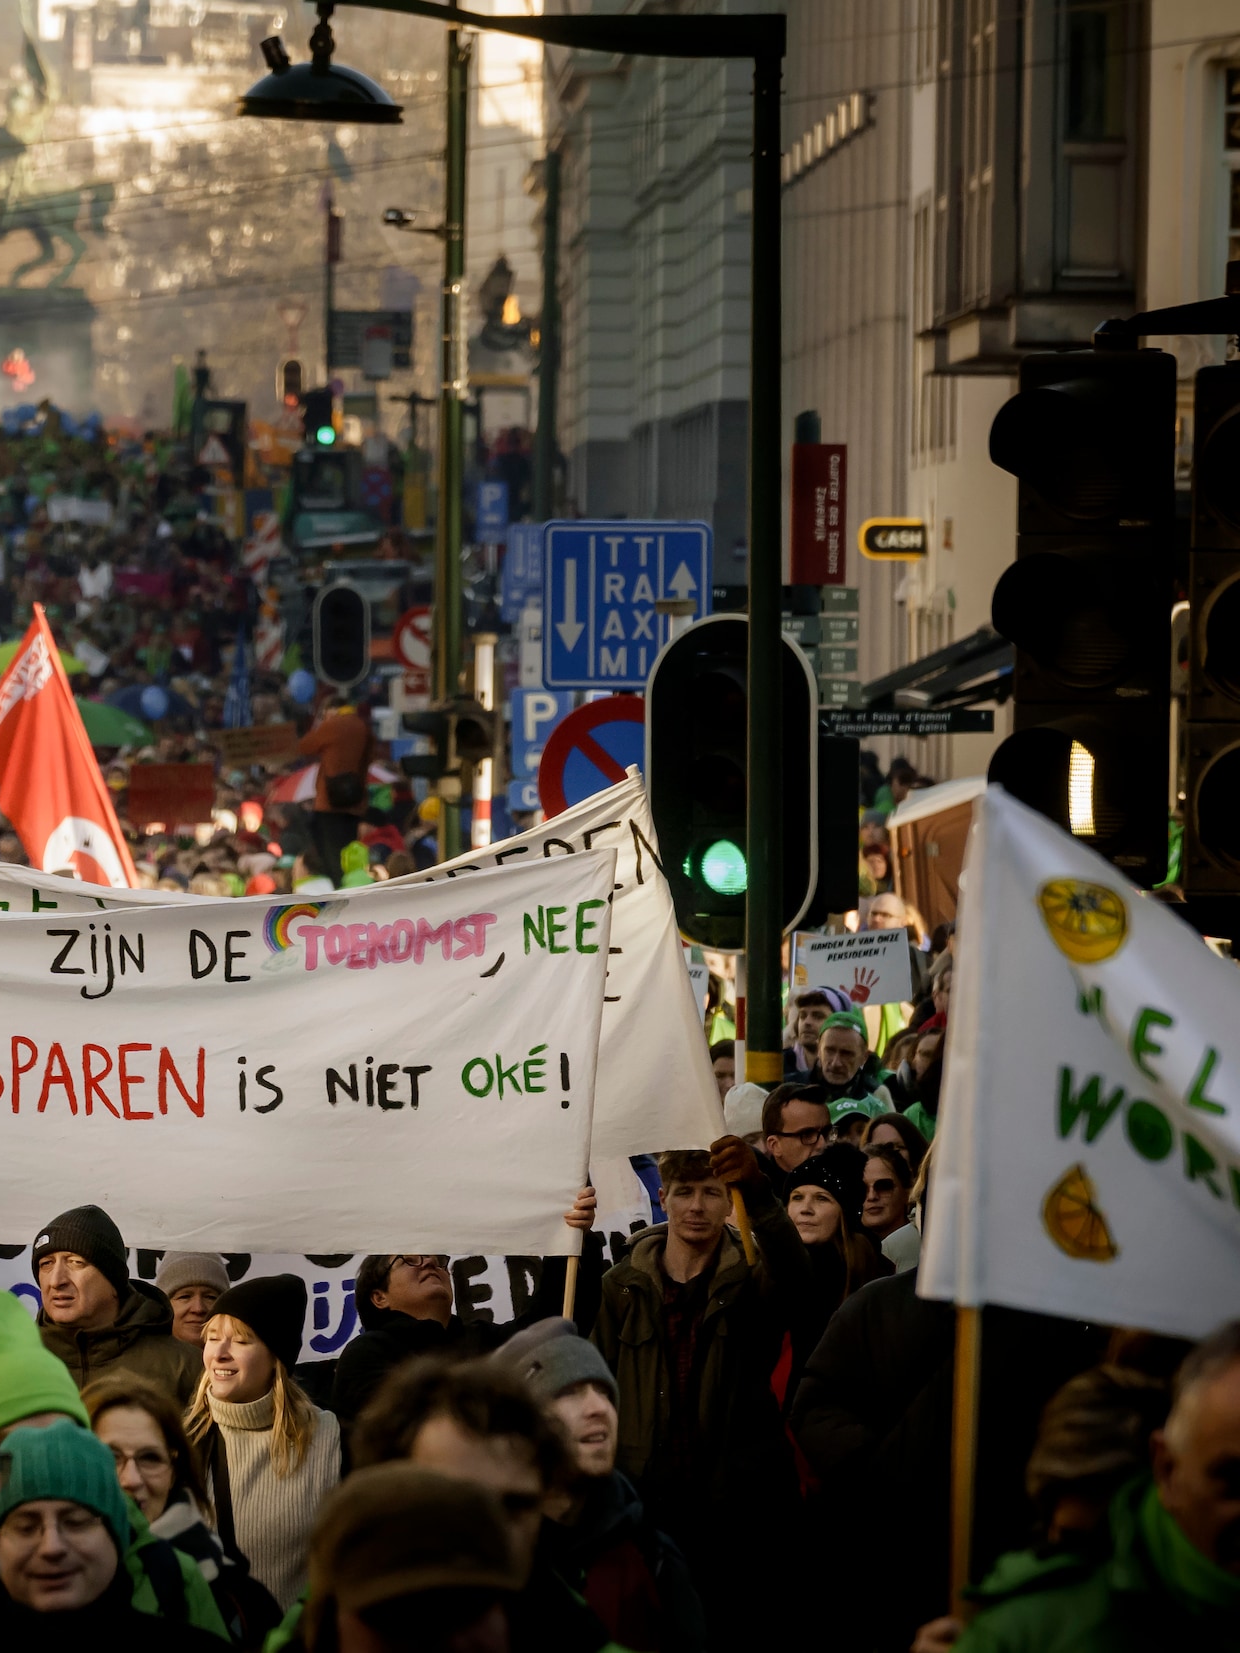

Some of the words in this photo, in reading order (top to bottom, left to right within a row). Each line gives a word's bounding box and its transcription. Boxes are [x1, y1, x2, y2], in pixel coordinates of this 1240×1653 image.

[874, 529, 922, 549] CASH
[599, 535, 628, 678] TRAM
[631, 535, 656, 678] TAXI
[524, 694, 558, 742] P
[830, 712, 850, 722] Parc
[189, 927, 252, 982] DE
[523, 898, 606, 957] NEE
[810, 938, 844, 952] HANDEN
[846, 937, 856, 948] AF
[858, 936, 875, 947] VAN
[877, 932, 899, 945] ONZE
[239, 1056, 284, 1114] iS
[325, 1055, 432, 1111] NiET
[1057, 1063, 1240, 1210] WOR
